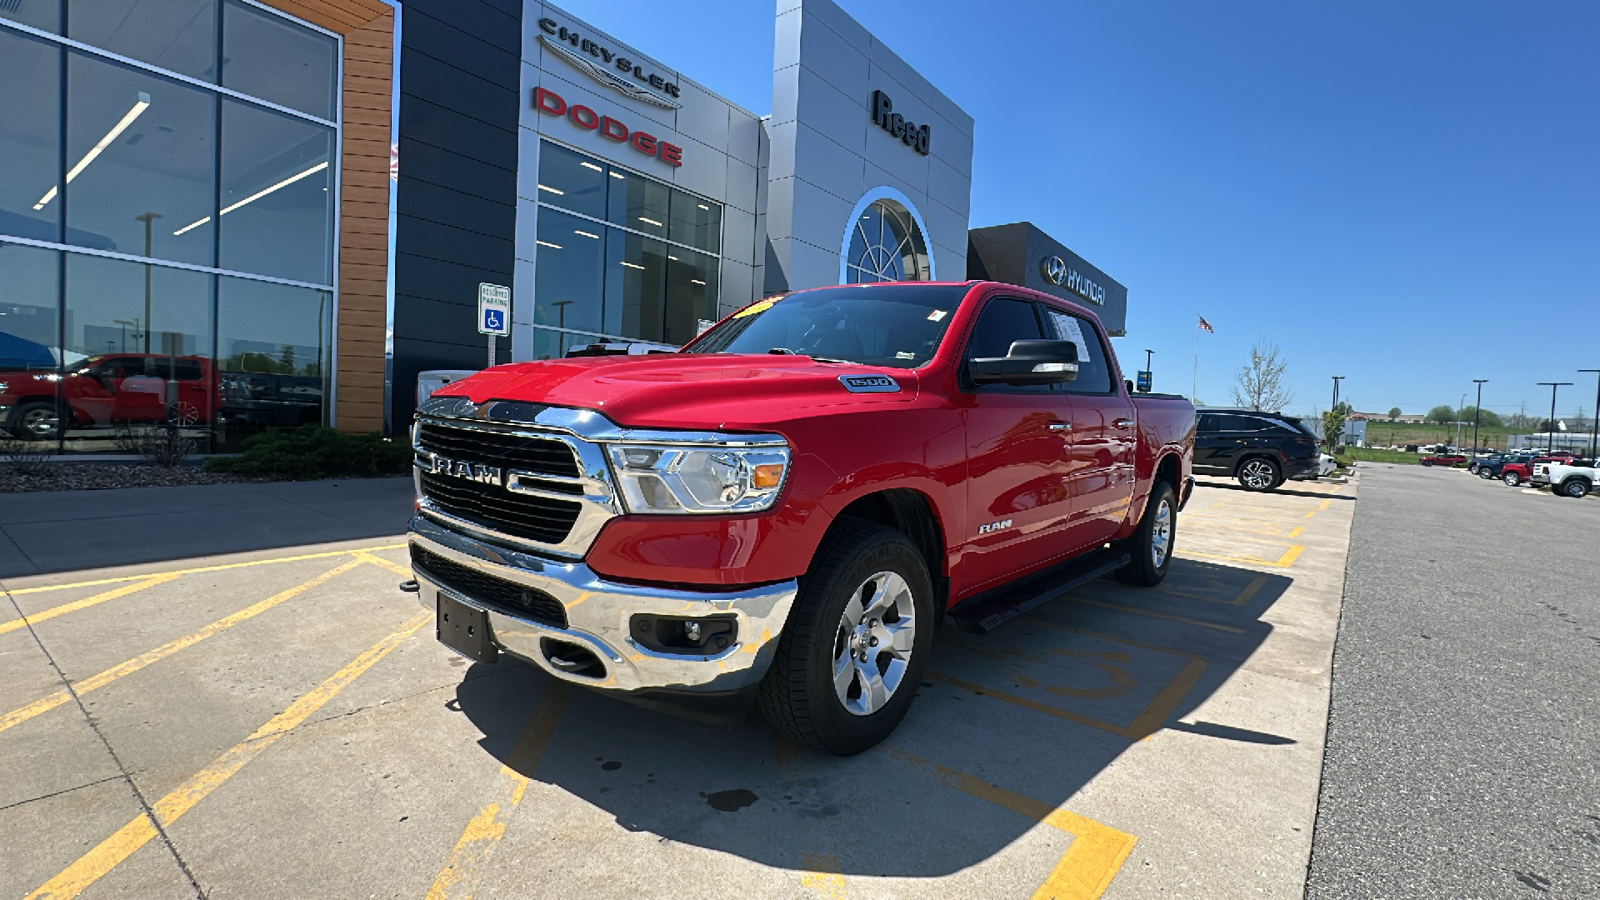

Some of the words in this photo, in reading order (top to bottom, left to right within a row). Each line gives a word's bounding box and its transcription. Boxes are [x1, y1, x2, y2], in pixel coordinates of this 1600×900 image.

[539, 17, 681, 98] CHRYSLER
[532, 86, 682, 167] DODGE
[873, 89, 930, 157] Reed
[482, 287, 508, 299] RESERVED
[482, 296, 508, 307] PARKING
[1067, 267, 1106, 306] HYUNDAI
[847, 377, 891, 387] 1500
[430, 453, 502, 487] RAM
[979, 518, 1013, 534] RAM
